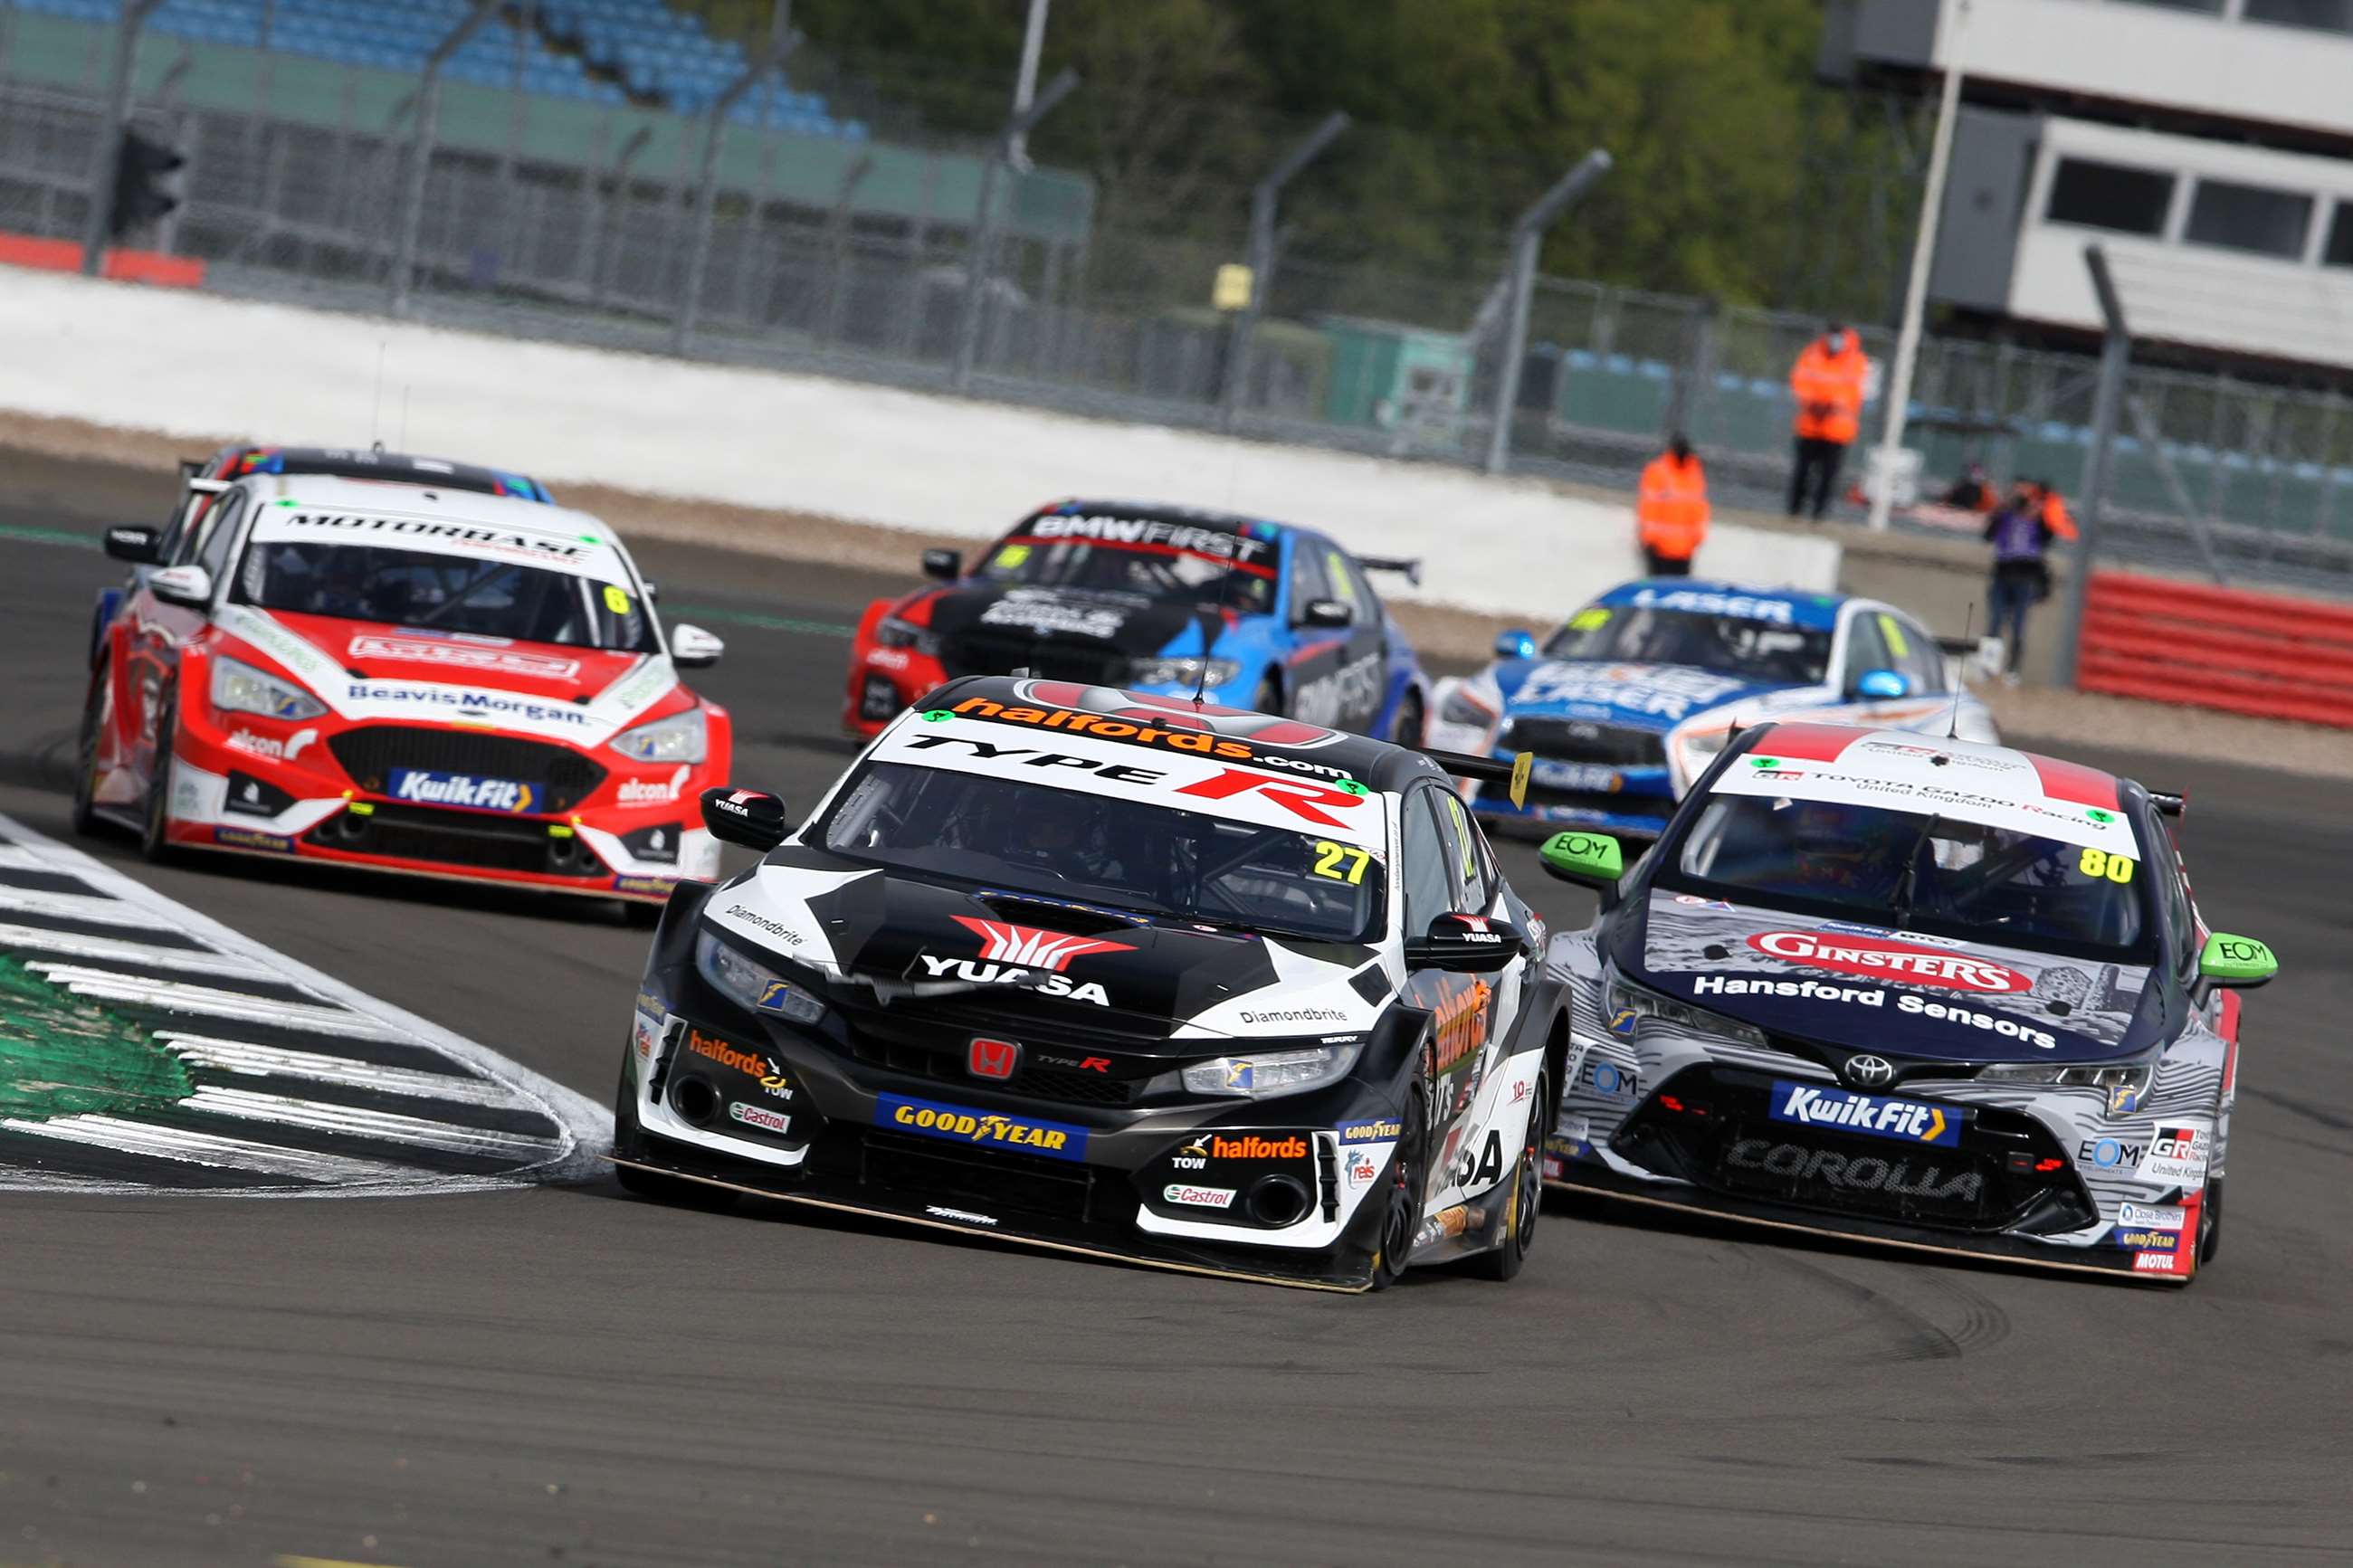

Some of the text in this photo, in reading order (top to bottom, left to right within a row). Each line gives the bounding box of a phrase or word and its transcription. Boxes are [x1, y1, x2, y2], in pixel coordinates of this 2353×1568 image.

[287, 513, 595, 557] MOTORBASE
[905, 734, 1365, 832] TYPE R
[1855, 782, 1994, 810] United Kingdom
[713, 798, 749, 817] YUASA
[1813, 772, 1914, 790] TOYOTA
[2021, 803, 2108, 832] Racing
[1554, 834, 1608, 860] EOM
[1313, 840, 1370, 886] 27
[2079, 848, 2134, 884] 80
[724, 904, 804, 946] Diamondbrite
[1462, 932, 1502, 945] YUASA
[2218, 941, 2268, 962] EOM
[1239, 1007, 1348, 1024] Diamondbrite
[1692, 975, 2057, 1050] Hansford Sensors
[689, 1029, 769, 1079] halfords
[1078, 1056, 1112, 1073] R
[743, 1107, 788, 1131] Castrol
[1213, 1136, 1309, 1159] halfords
[1172, 1157, 1205, 1170] TOW
[1727, 1138, 1983, 1203] COROLLA
[1180, 1187, 1229, 1205] Castrol
[2137, 1253, 2175, 1269] MOTUL
